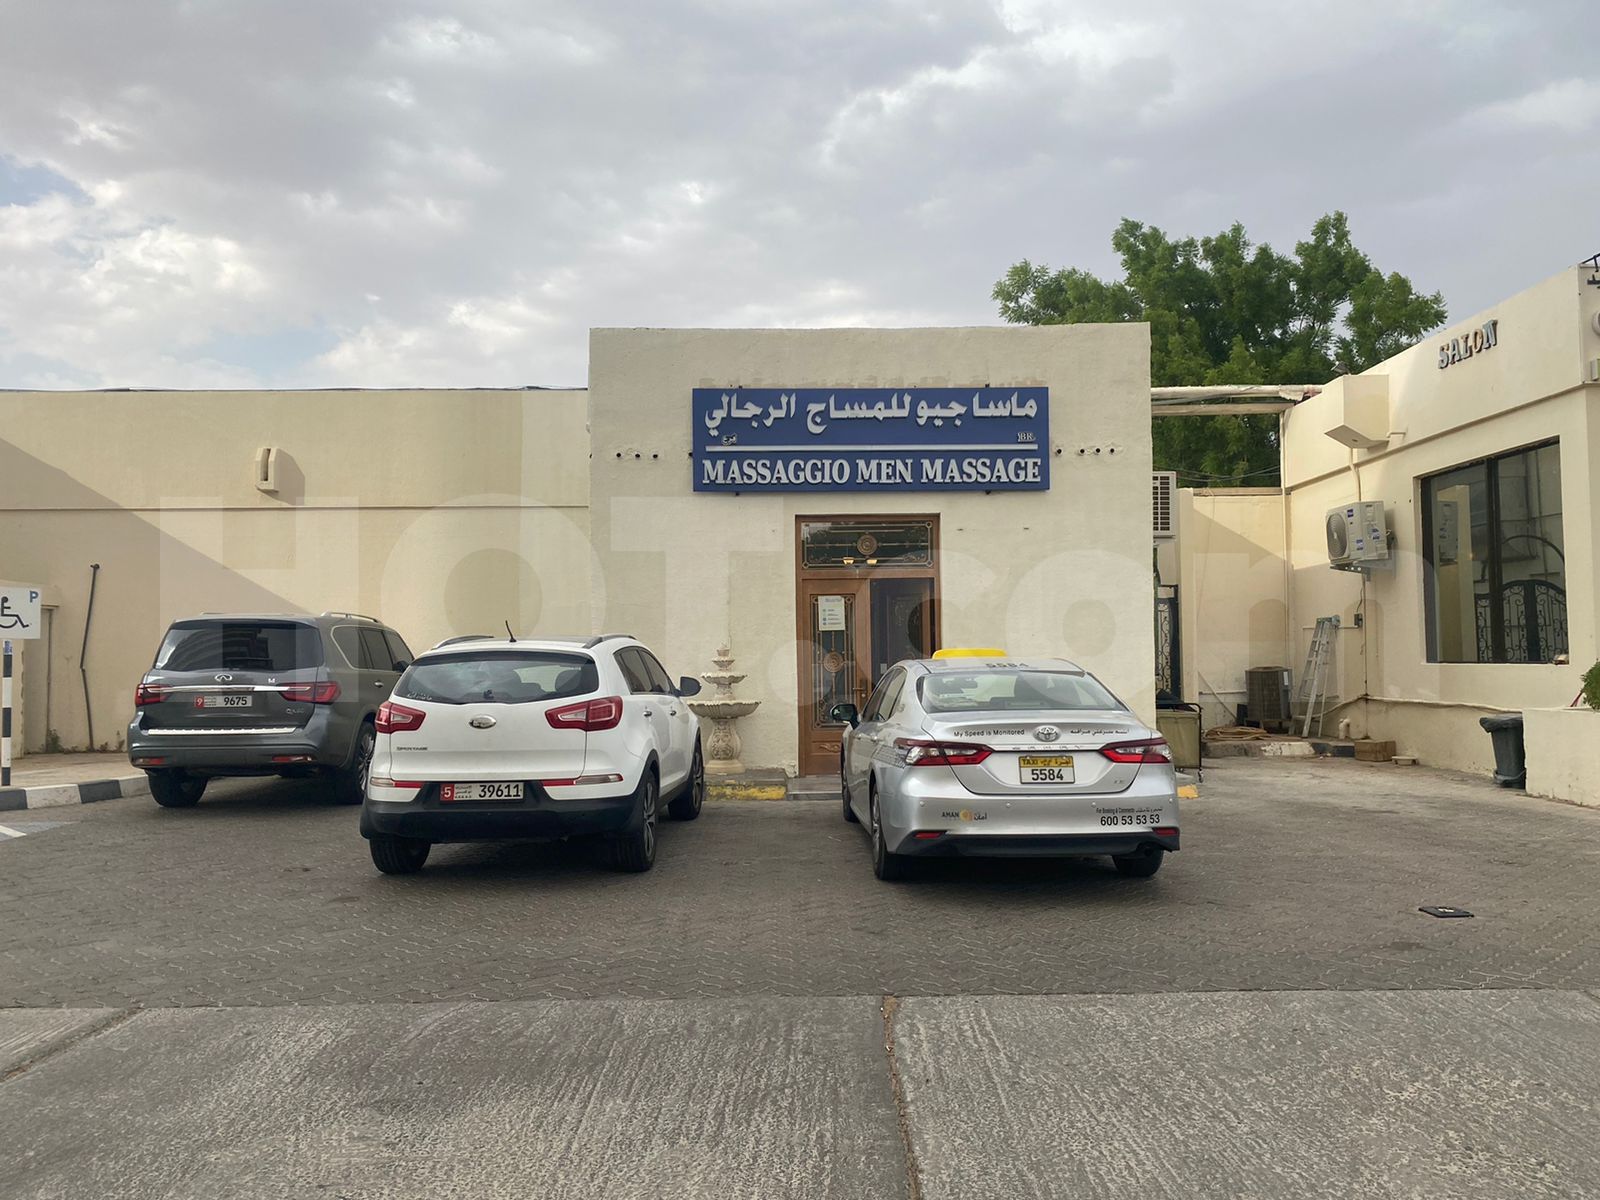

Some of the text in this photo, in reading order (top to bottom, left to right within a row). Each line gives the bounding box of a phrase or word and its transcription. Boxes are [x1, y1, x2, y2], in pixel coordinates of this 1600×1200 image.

[1438, 320, 1498, 369] SALON
[704, 392, 797, 437] الرجالي
[806, 392, 912, 435] للمساج
[702, 457, 1042, 484] MASSAGGIO MEN MASSAGE
[29, 590, 39, 603] P
[196, 697, 203, 706] 9
[223, 696, 248, 706] 9675
[953, 730, 963, 738] My
[965, 730, 985, 738] Speed
[993, 728, 1025, 736] Monitored
[1031, 768, 1064, 781] 5584
[443, 786, 451, 798] 5
[478, 784, 521, 798] 39611
[1100, 813, 1160, 826] 600 53 53 53
